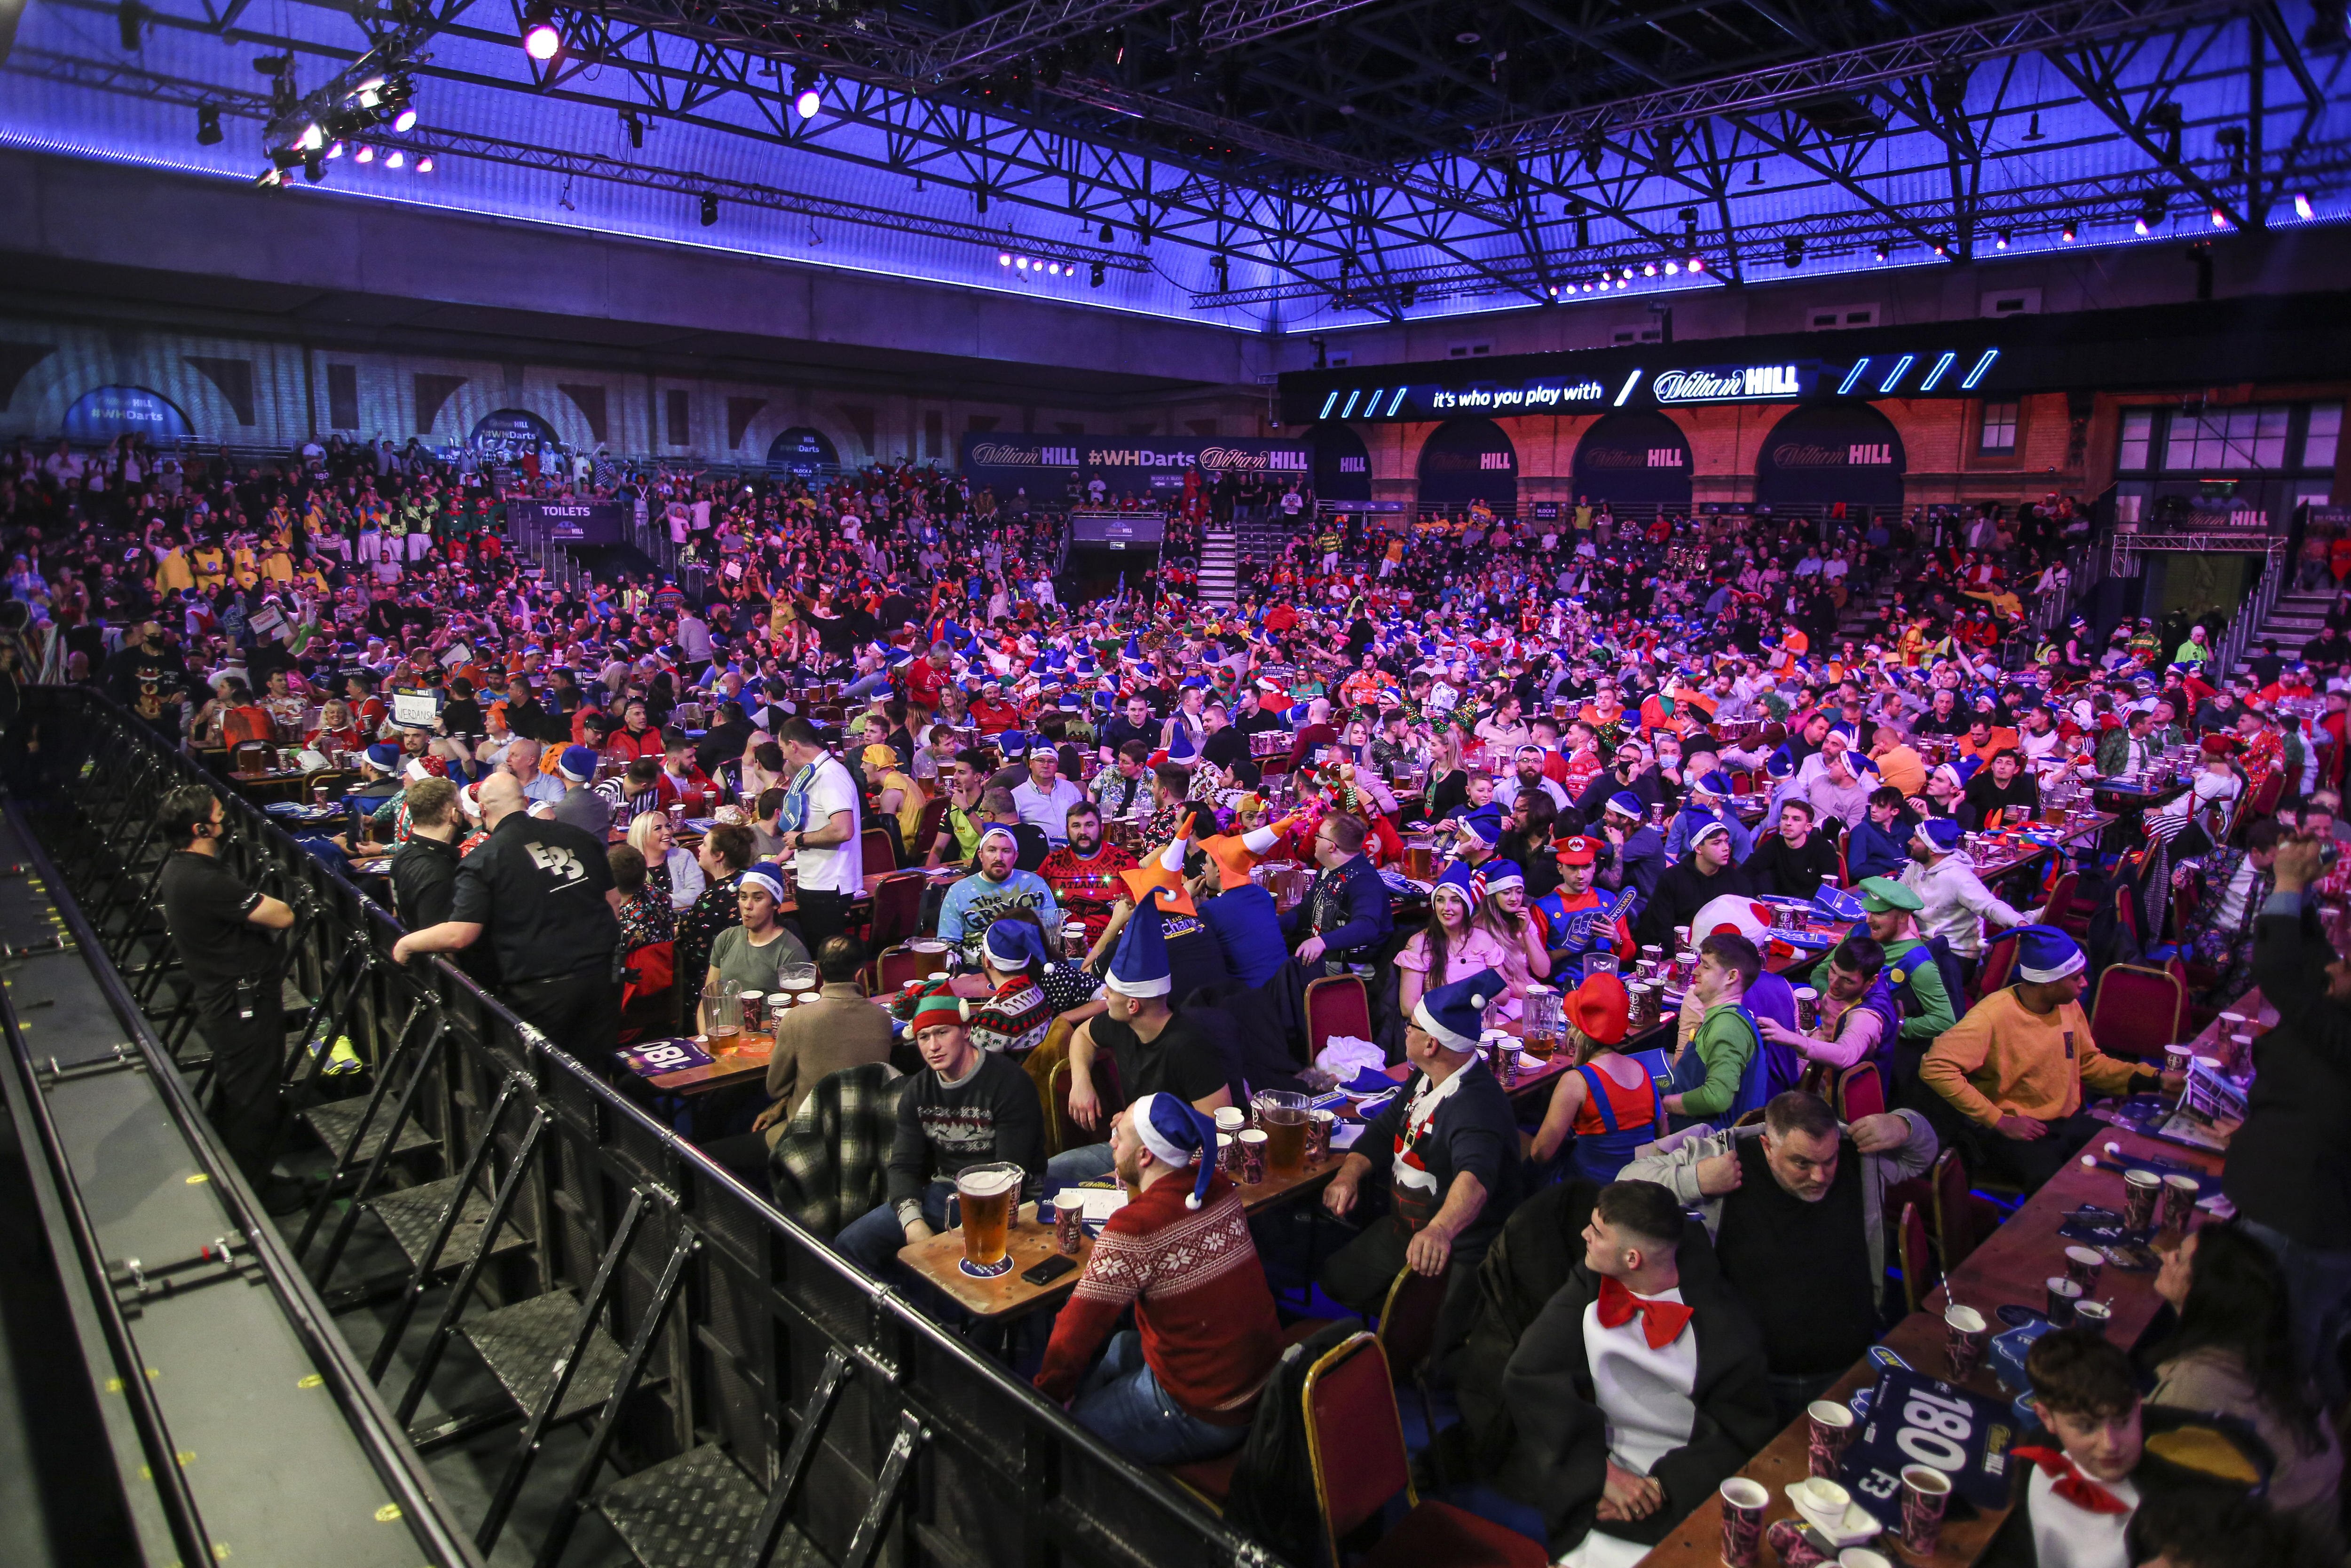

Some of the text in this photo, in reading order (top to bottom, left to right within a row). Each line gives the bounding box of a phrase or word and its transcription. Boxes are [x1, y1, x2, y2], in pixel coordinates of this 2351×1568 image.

[1653, 366, 1799, 402] William HILL
[133, 399, 152, 408] HILL
[1433, 382, 1602, 408] it's who you play with
[972, 443, 1308, 469] William HILL #WHDarts William HILL
[1481, 452, 1510, 469] HILL
[1648, 448, 1683, 467] HILL
[1848, 444, 1892, 464] HILL
[1340, 457, 1365, 472] HILL
[542, 506, 591, 516] TOILETS
[2230, 511, 2268, 526] HILL
[969, 893, 1004, 907] The
[632, 1041, 692, 1069] 180
[1896, 1387, 1973, 1472] 180
